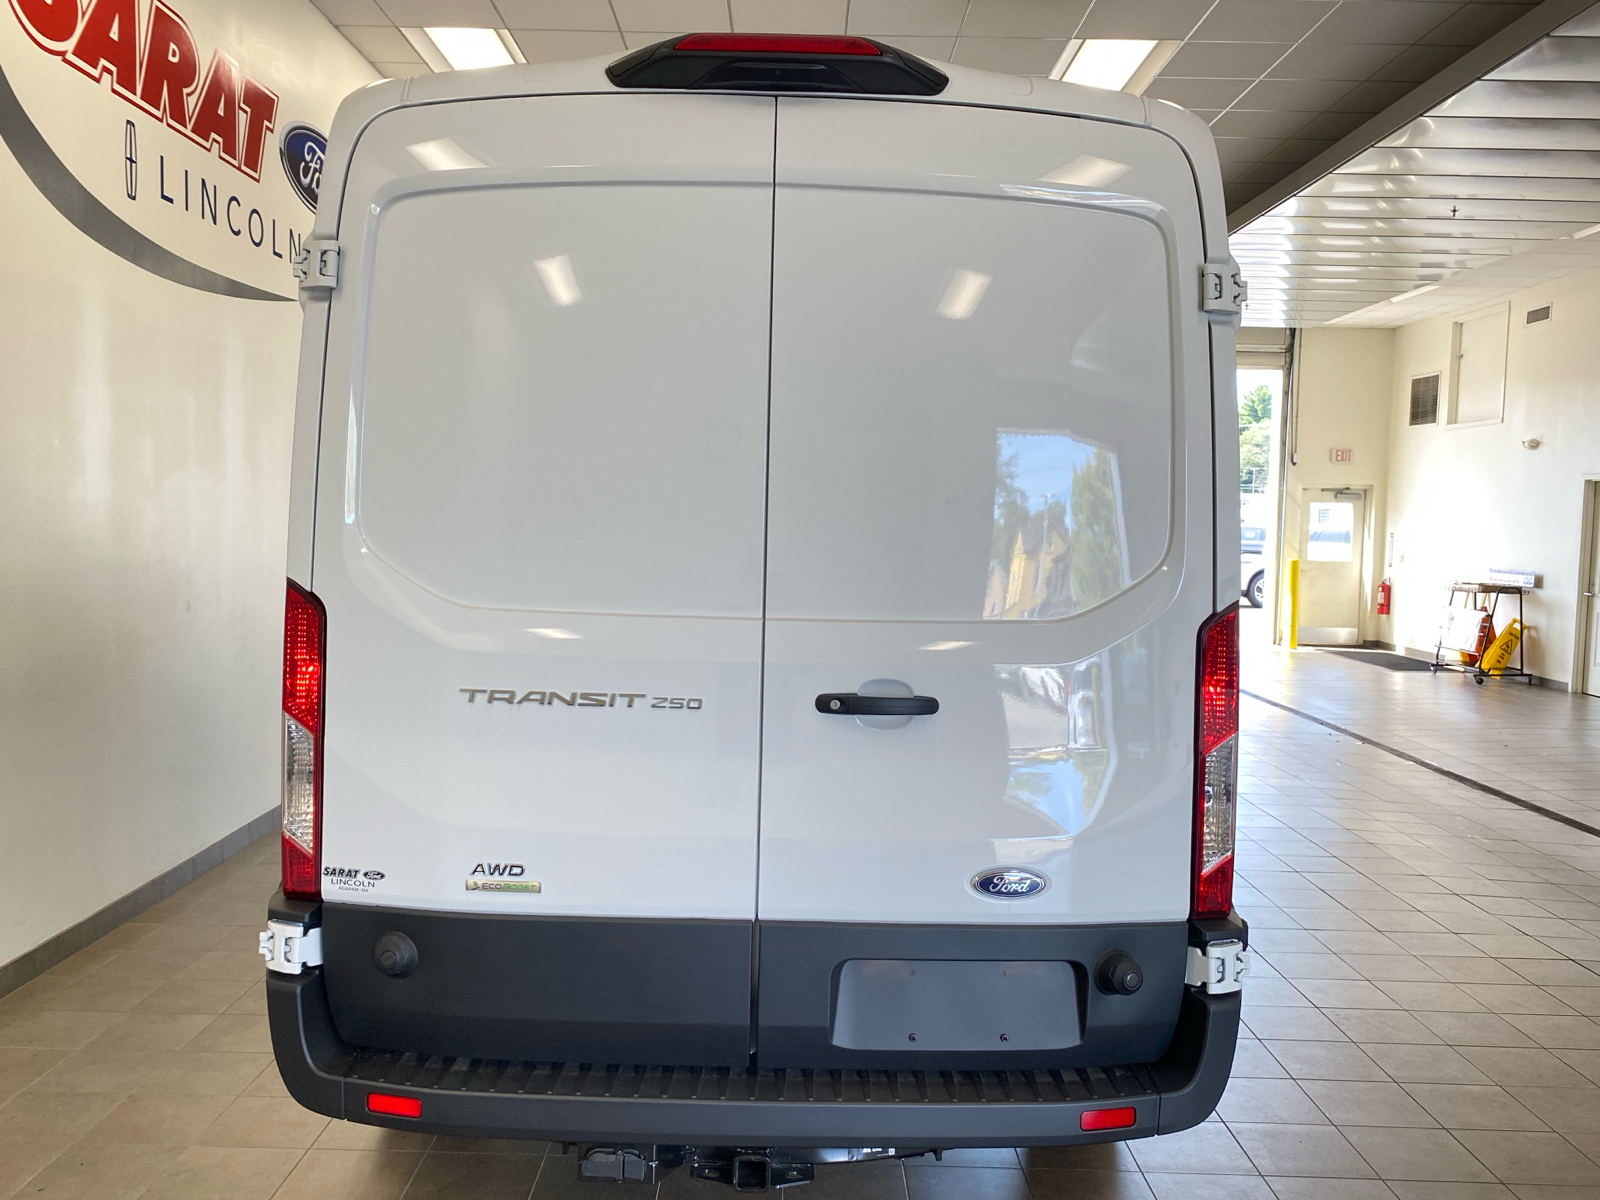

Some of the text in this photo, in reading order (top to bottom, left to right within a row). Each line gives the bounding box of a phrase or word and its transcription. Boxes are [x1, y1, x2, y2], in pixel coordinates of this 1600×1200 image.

[159, 154, 301, 264] LINCOLN
[1335, 449, 1352, 462] EXIT
[459, 688, 703, 710] TRANSIT 250
[323, 866, 361, 879] SARAT
[470, 863, 526, 877] AWD
[330, 878, 375, 888] LINCOLN
[989, 875, 1031, 893] Ford
